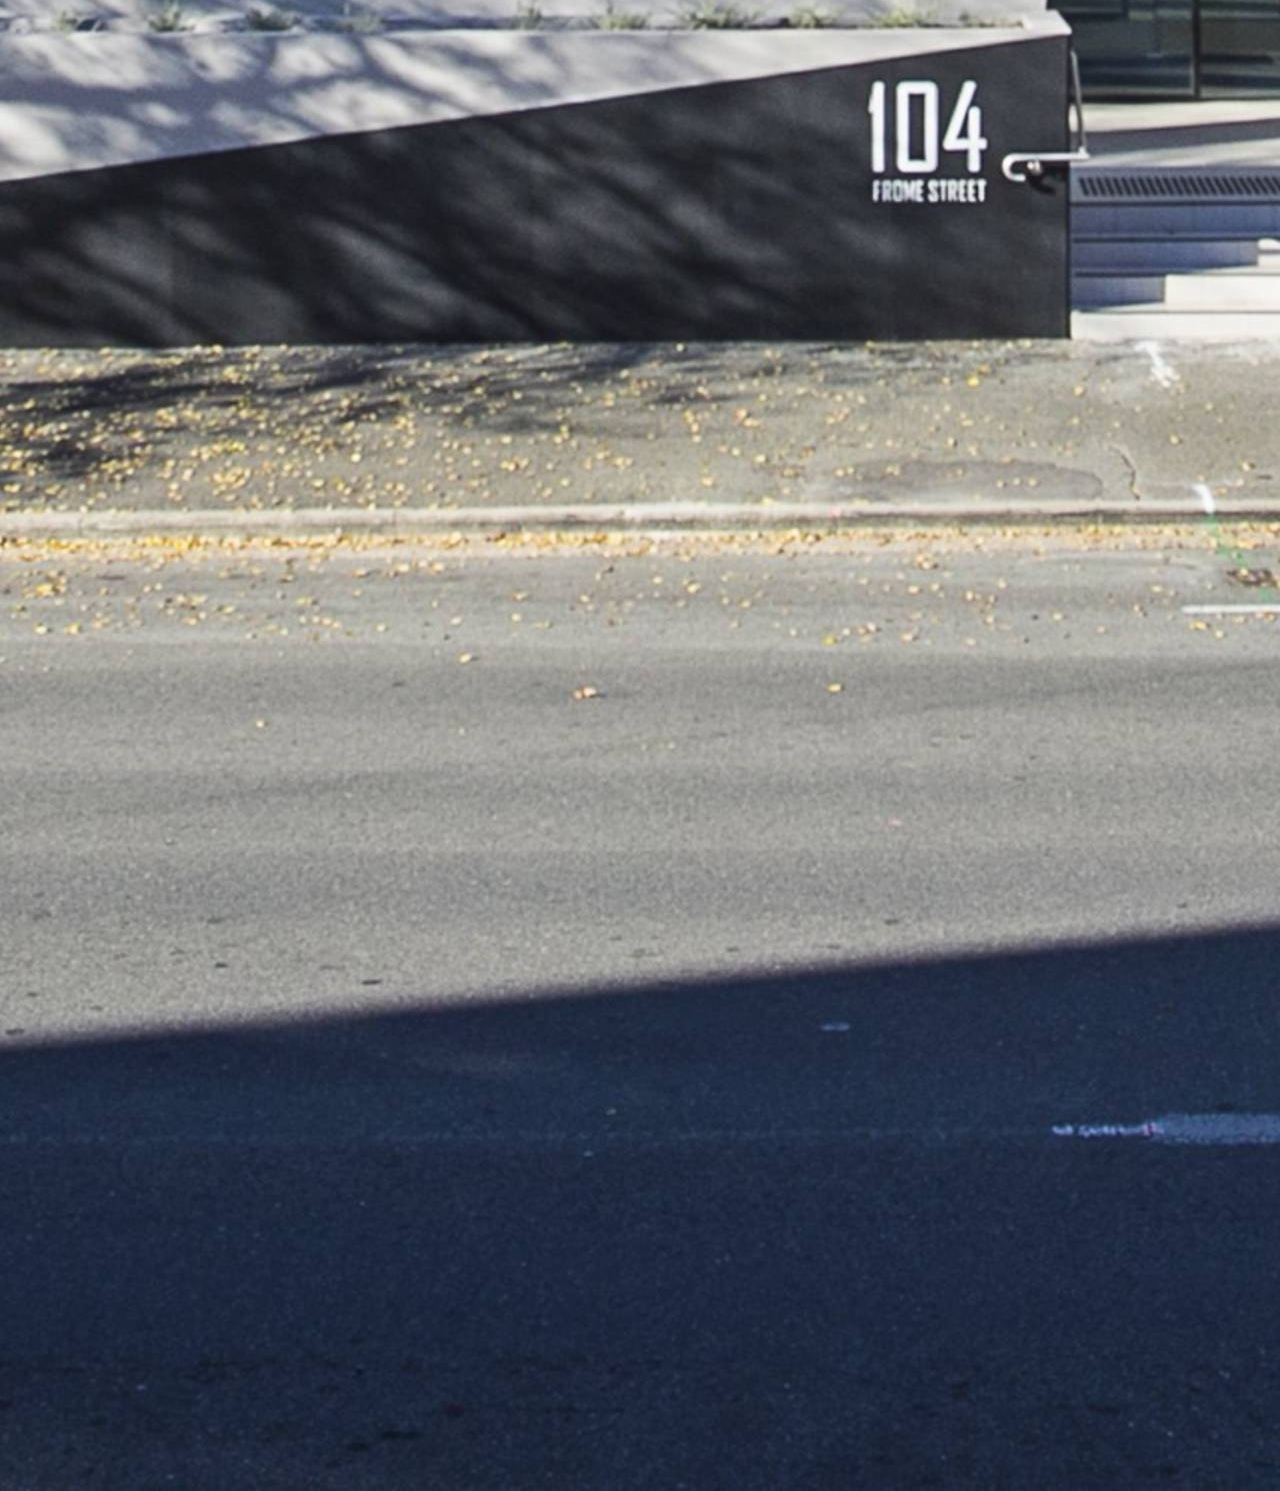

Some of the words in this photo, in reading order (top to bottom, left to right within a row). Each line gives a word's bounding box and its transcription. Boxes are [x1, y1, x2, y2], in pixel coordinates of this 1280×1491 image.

[868, 80, 988, 173] 104
[872, 178, 924, 203] FROME
[927, 178, 987, 203] STREET
